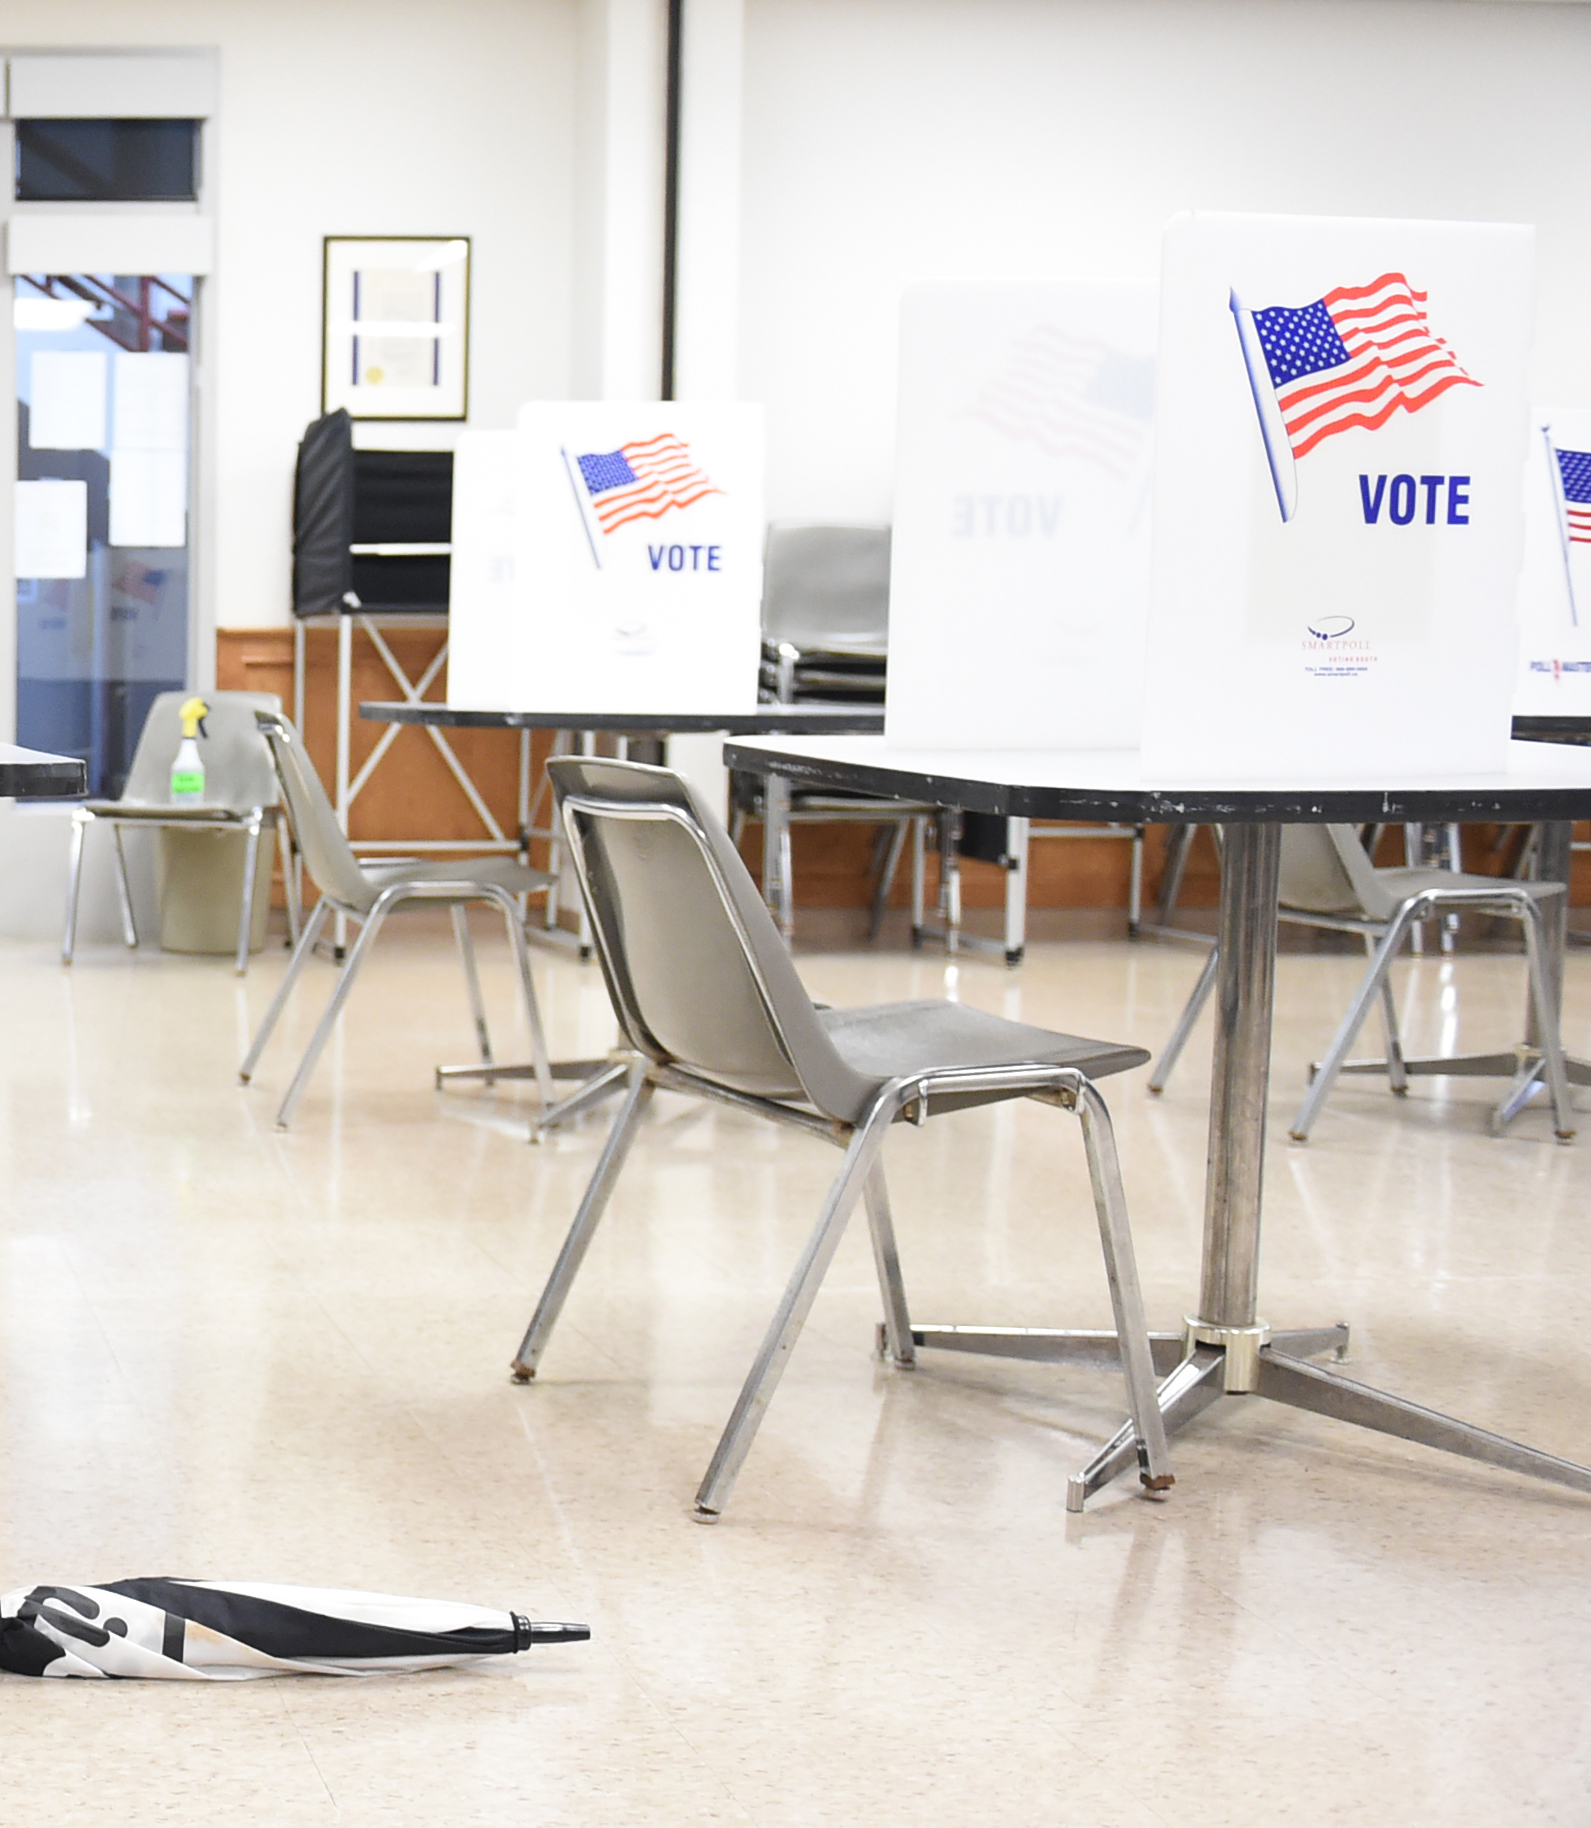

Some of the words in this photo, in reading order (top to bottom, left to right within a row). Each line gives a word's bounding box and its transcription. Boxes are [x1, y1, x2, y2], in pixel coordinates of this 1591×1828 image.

[1359, 473, 1471, 526] VOTE
[648, 545, 722, 572] VOTE
[1301, 640, 1371, 649] SMARTPOLL
